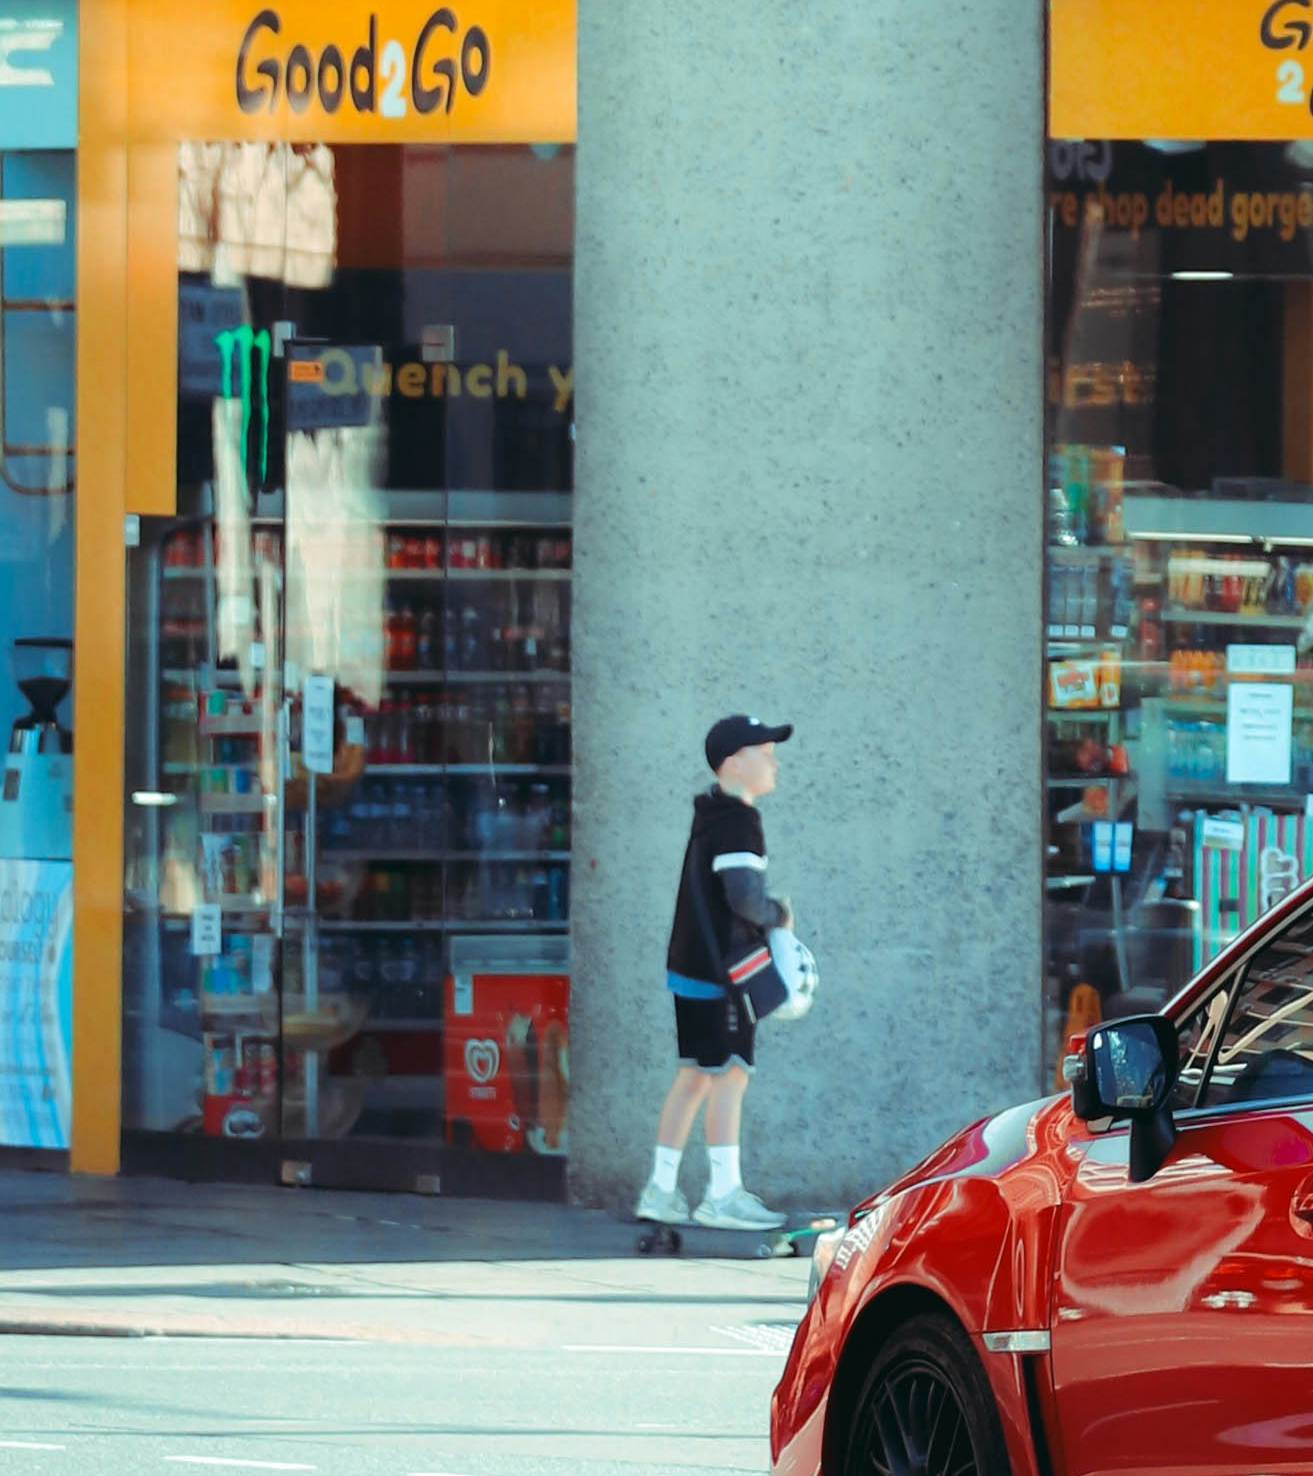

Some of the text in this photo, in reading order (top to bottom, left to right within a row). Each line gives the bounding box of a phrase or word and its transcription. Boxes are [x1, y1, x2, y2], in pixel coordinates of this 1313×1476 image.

[235, 7, 491, 118] Good2Go
[1156, 178, 1224, 227] dead
[320, 348, 527, 398] Quench
